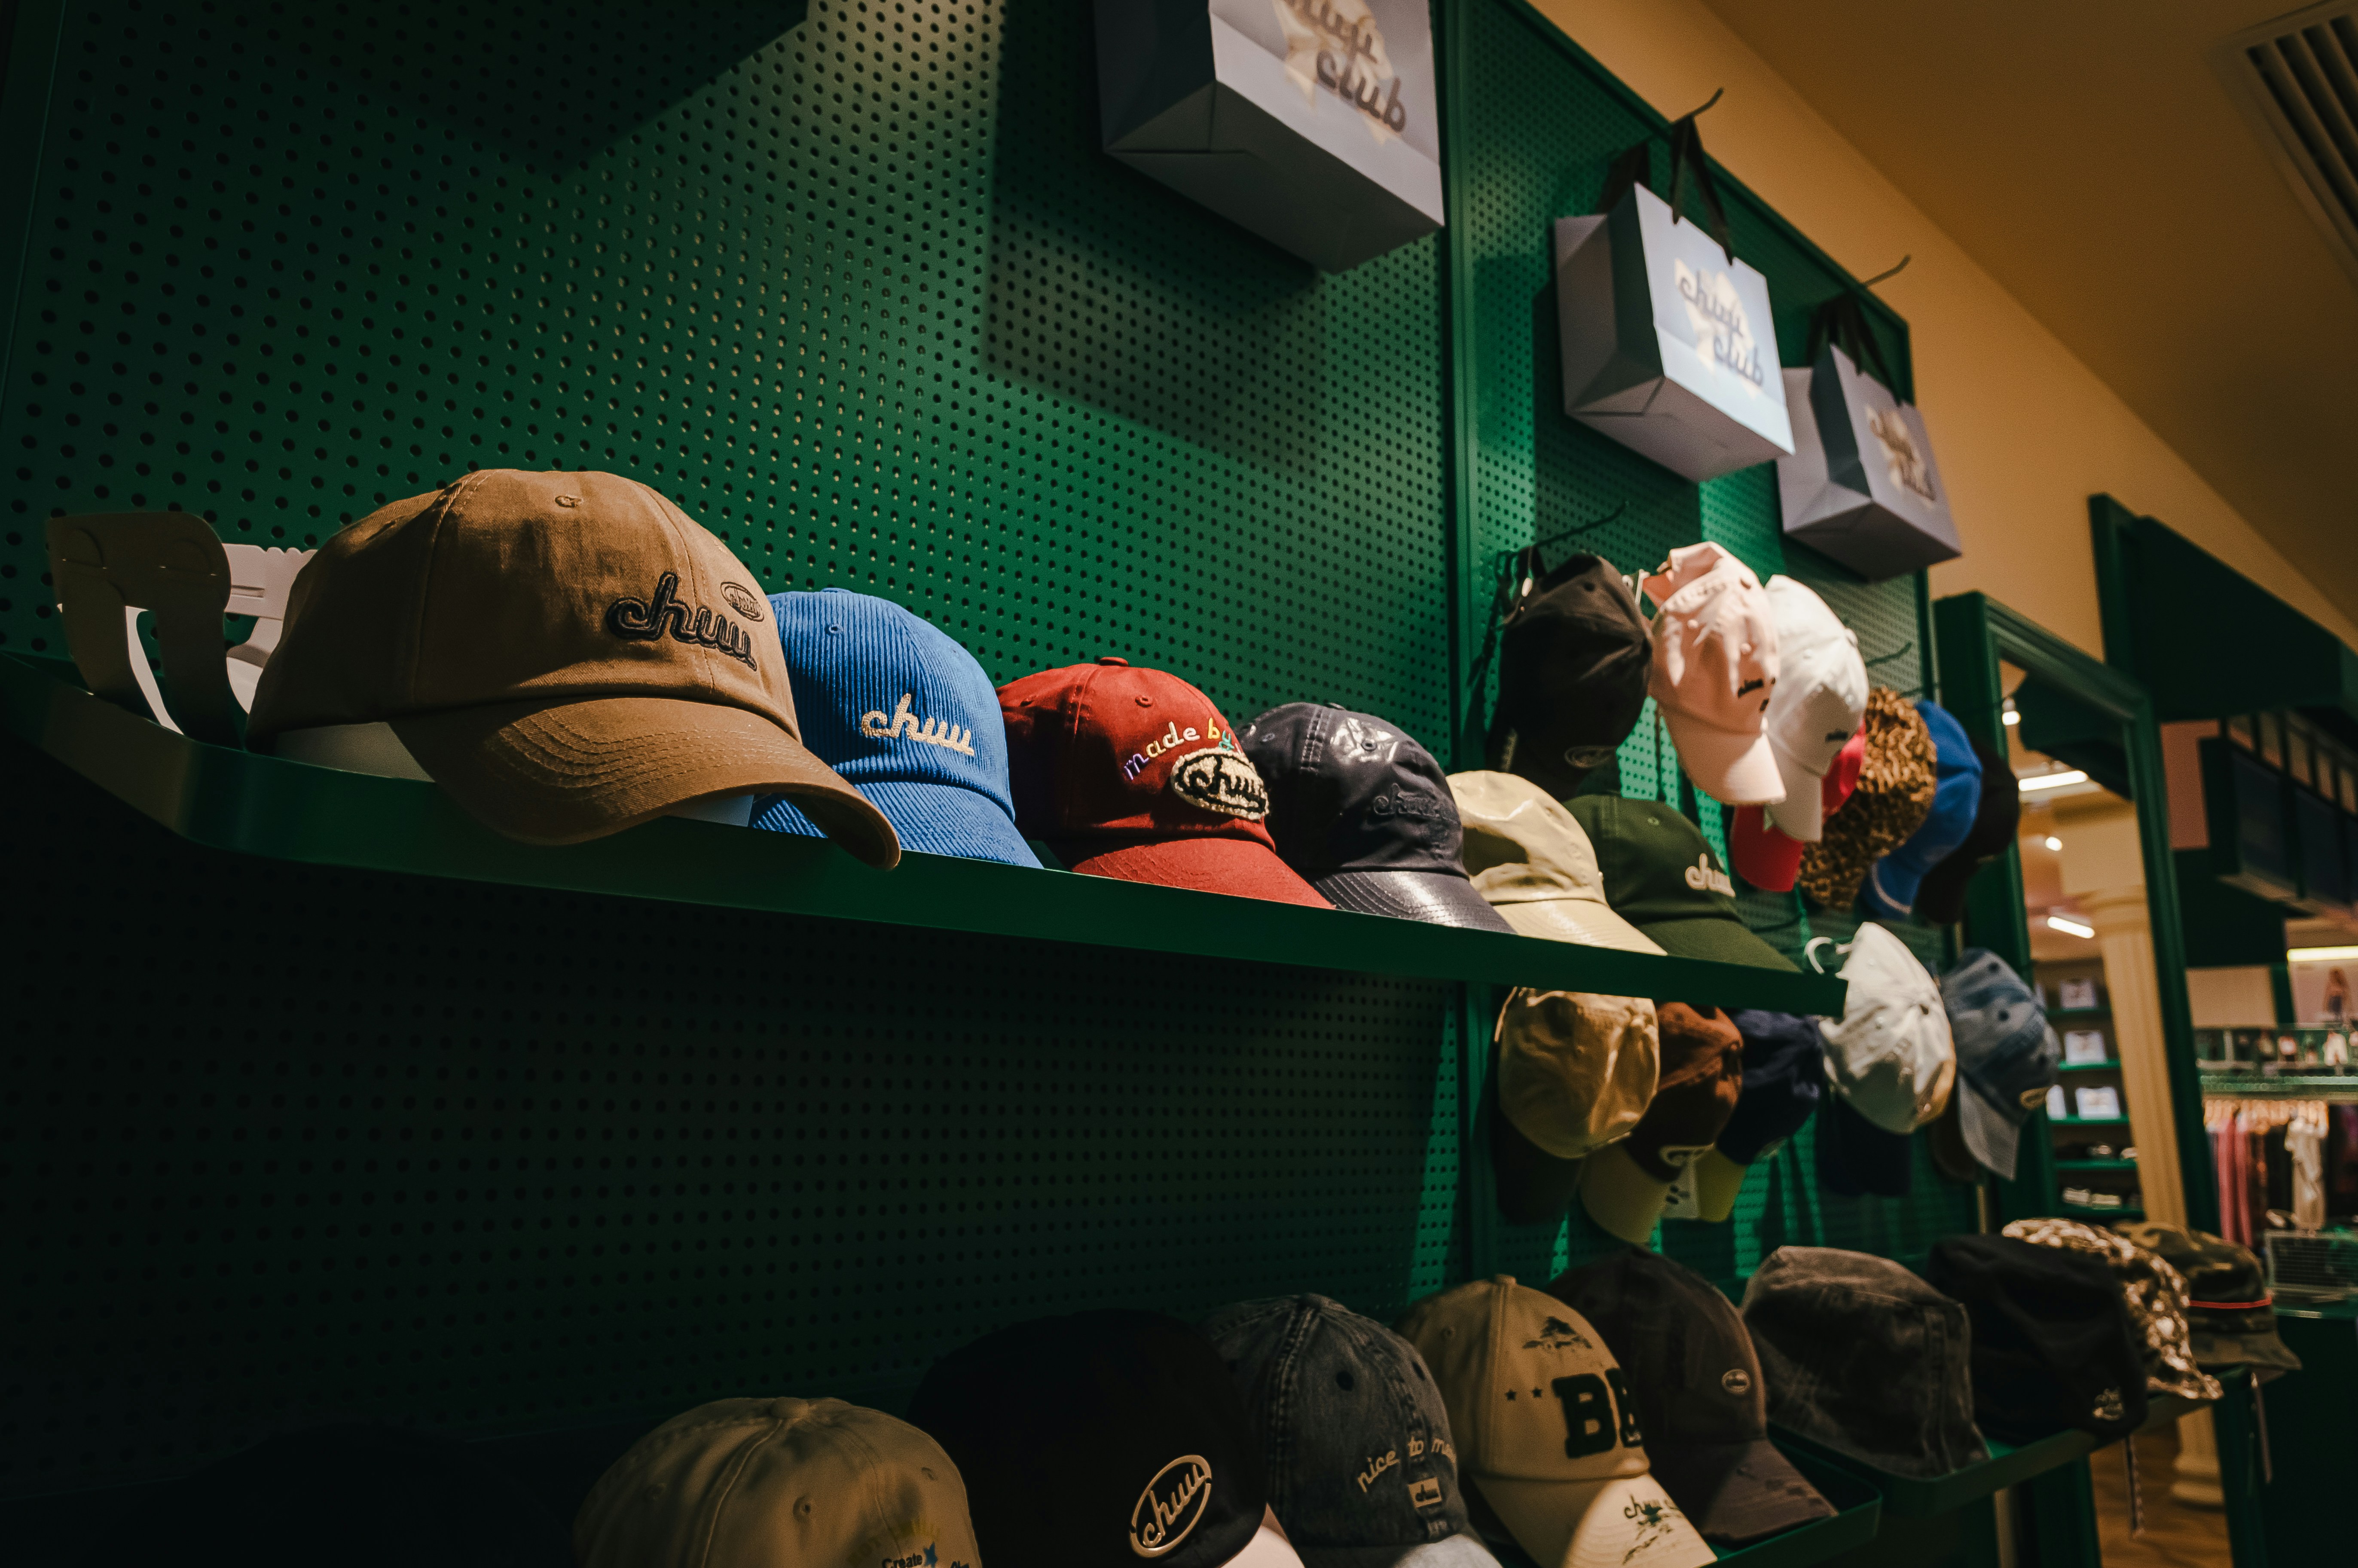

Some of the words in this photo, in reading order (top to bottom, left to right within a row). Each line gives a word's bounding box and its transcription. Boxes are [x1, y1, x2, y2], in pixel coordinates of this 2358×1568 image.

[1316, 46, 1406, 132] club
[861, 692, 975, 757] chuu
[1123, 721, 1200, 780] made
[1207, 717, 1235, 751] by
[1357, 1450, 1400, 1493] nice
[1407, 1436, 1424, 1458] to
[882, 1553, 922, 1568] Create
